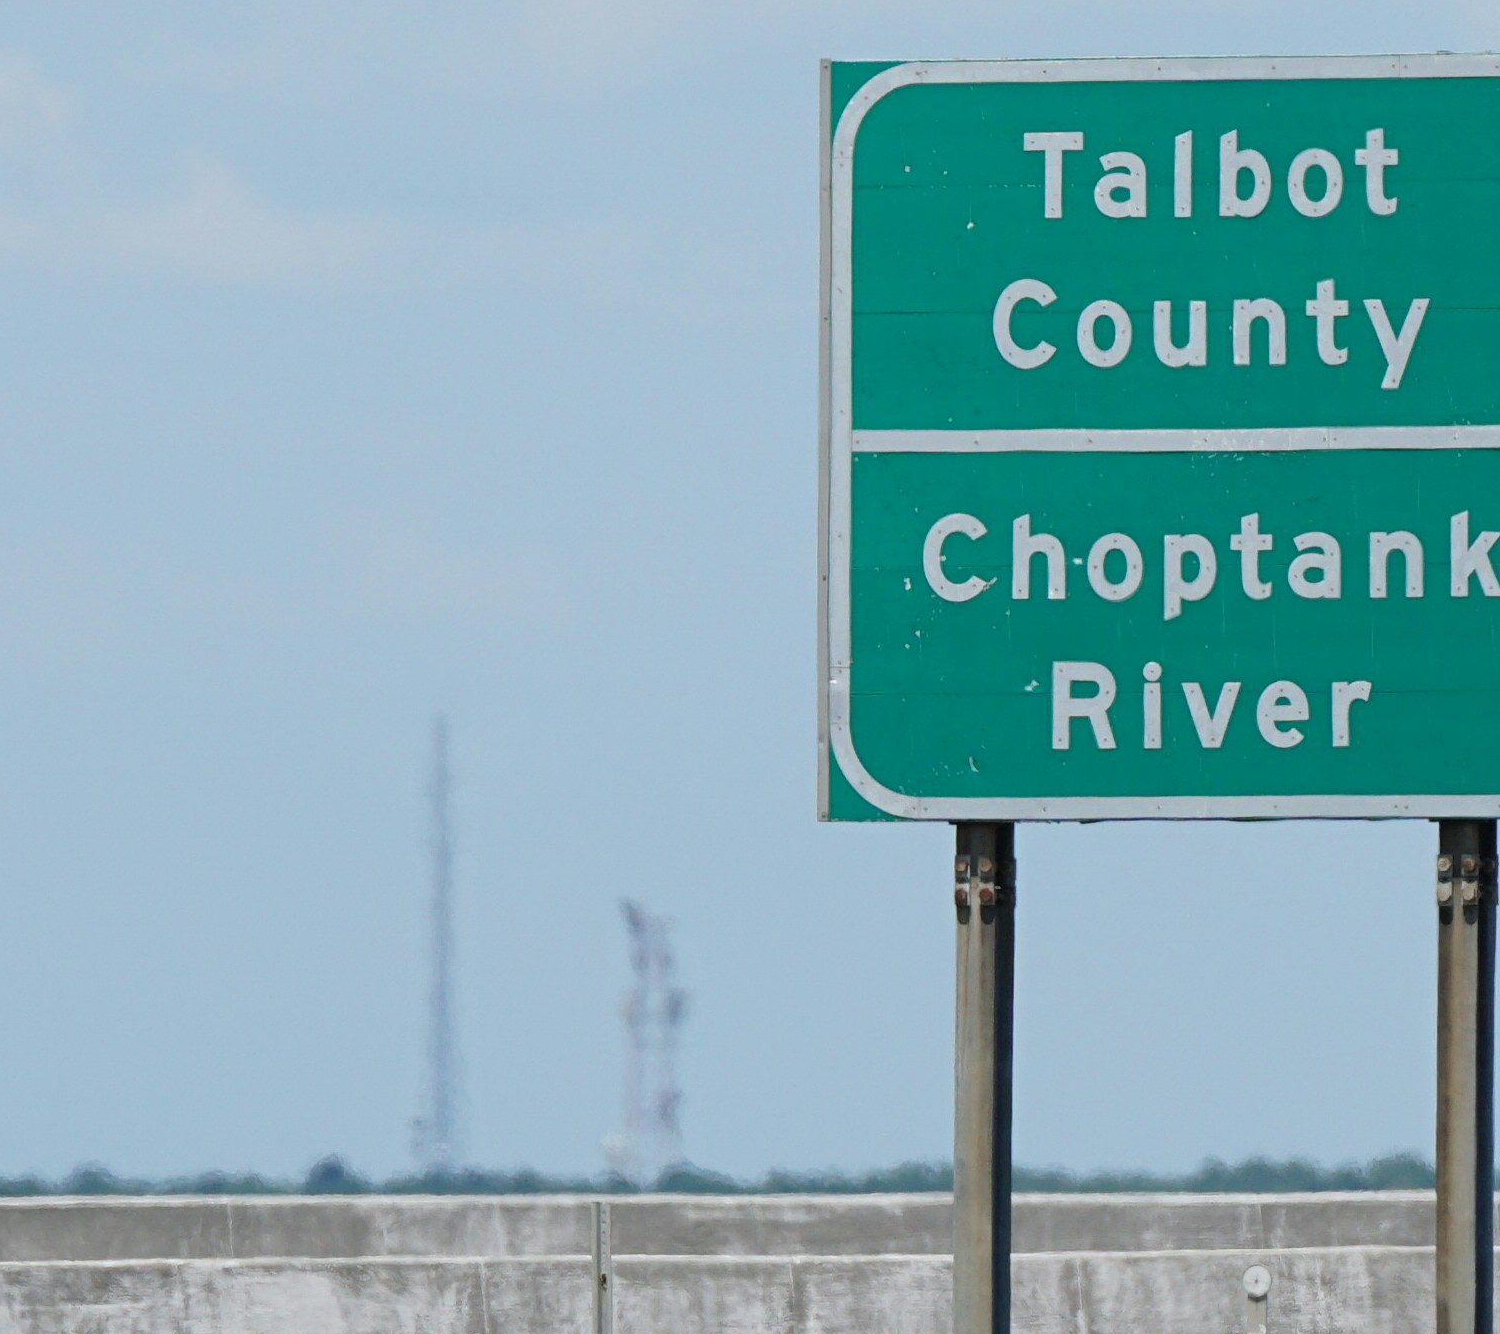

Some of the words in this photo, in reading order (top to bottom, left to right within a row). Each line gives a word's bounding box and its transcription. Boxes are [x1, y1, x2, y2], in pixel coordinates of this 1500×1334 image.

[1023, 127, 1399, 219] Talbot
[992, 278, 1430, 390] County
[1051, 660, 1372, 750] River
